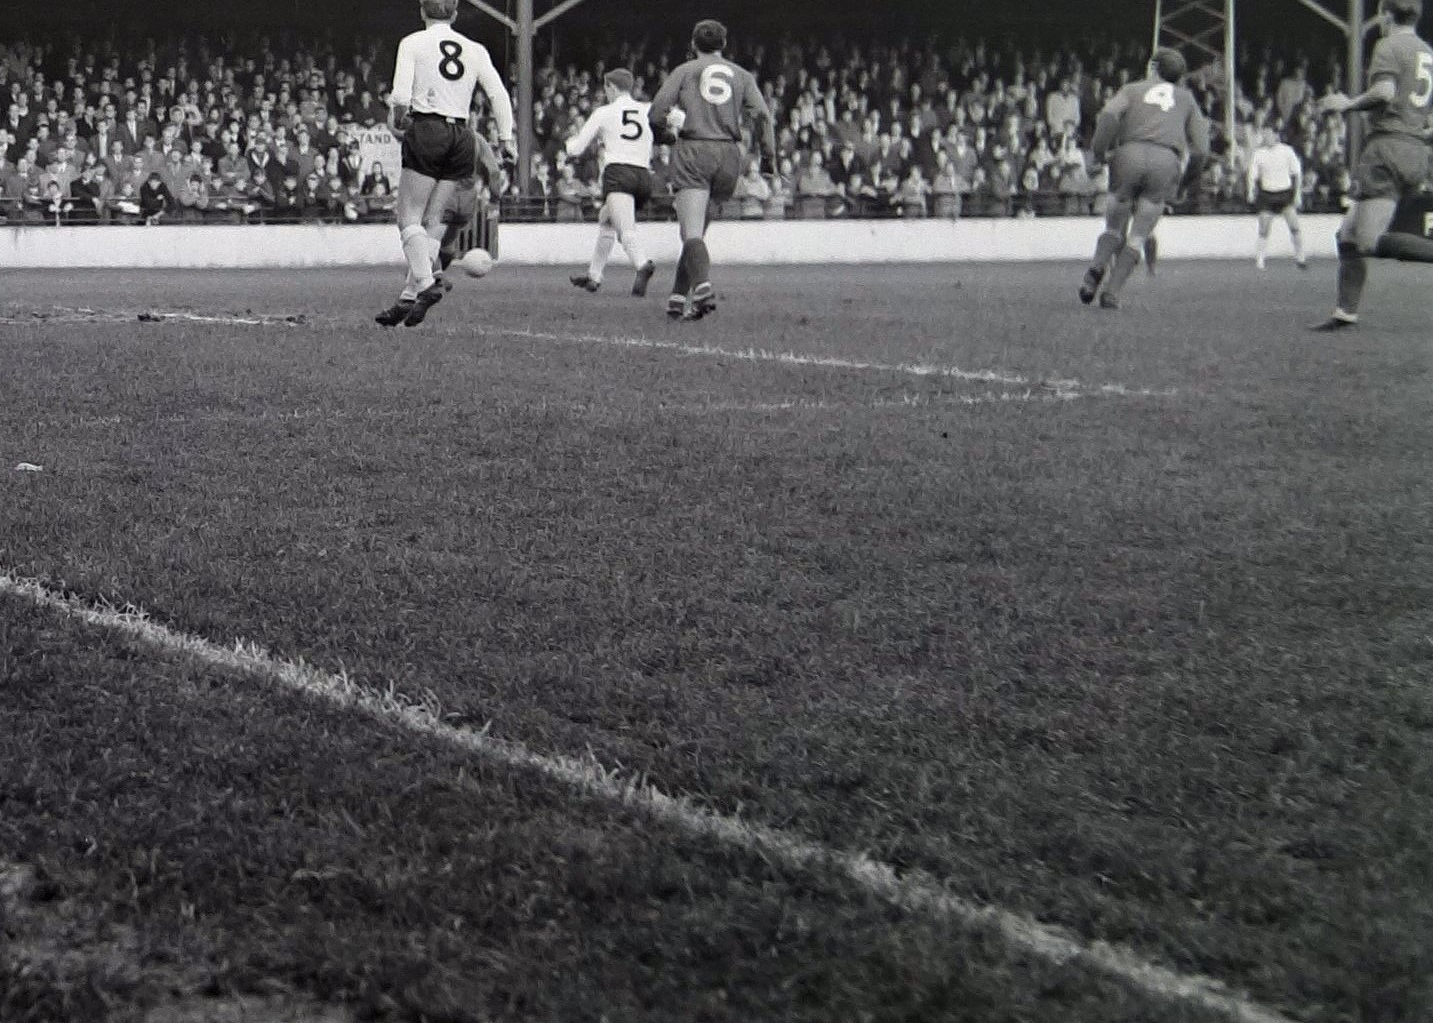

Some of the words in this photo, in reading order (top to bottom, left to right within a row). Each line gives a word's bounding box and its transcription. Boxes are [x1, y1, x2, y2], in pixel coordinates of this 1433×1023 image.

[438, 40, 465, 81] 8
[699, 64, 734, 105] 6
[1144, 82, 1176, 112] 4
[620, 110, 643, 140] 5
